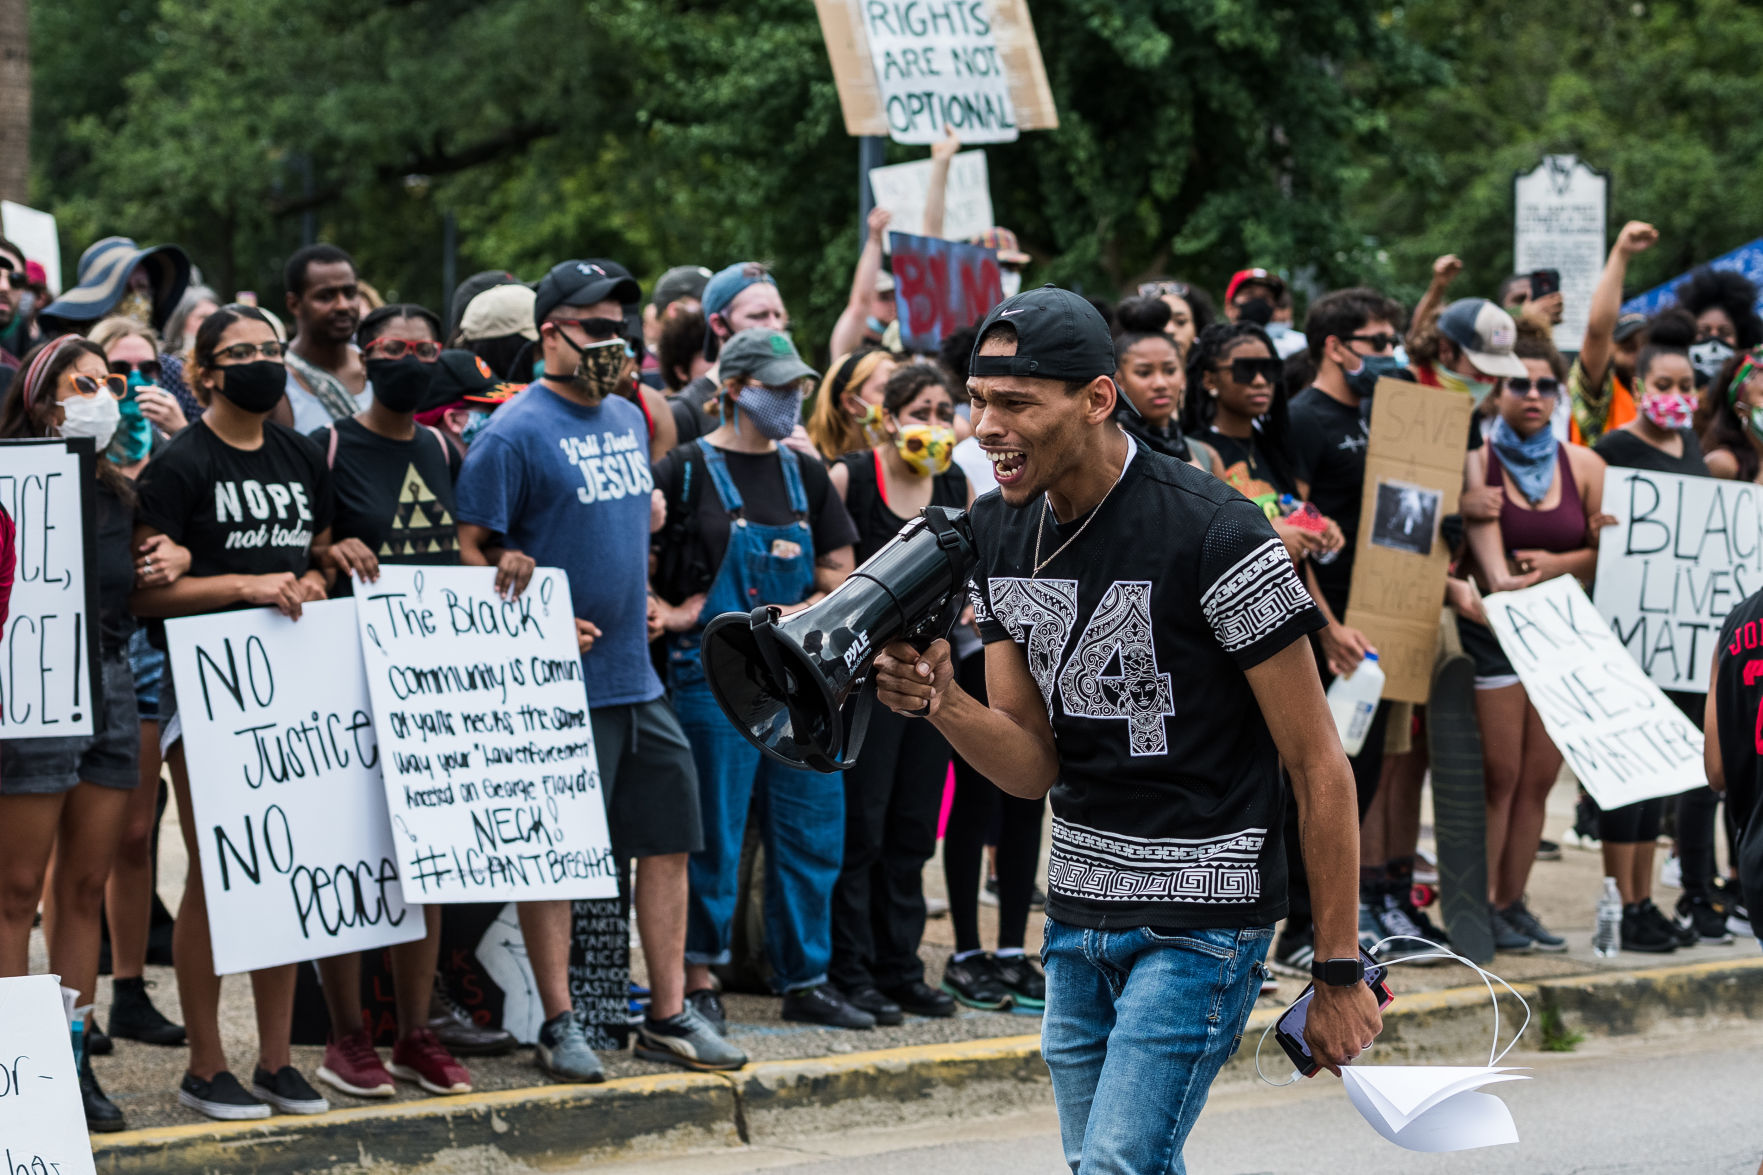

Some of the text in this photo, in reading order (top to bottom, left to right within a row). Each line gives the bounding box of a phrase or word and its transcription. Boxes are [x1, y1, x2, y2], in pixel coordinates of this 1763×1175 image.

[868, 1, 991, 37] RIGHTS
[884, 46, 1001, 80] ARE NOT
[886, 91, 1016, 133] OPTIONAL
[1382, 390, 1471, 448] SAVE
[215, 479, 313, 522] NOPE
[577, 450, 655, 504] JESUS
[225, 518, 313, 558] not today
[367, 593, 437, 638] The
[843, 629, 870, 669] PYLE
[988, 577, 1175, 756] 74
[1611, 615, 1722, 684] MAT
[196, 635, 274, 721] NO
[1534, 661, 1655, 729] LIVES
[1566, 719, 1706, 795] MATTER
[213, 804, 294, 892] NO
